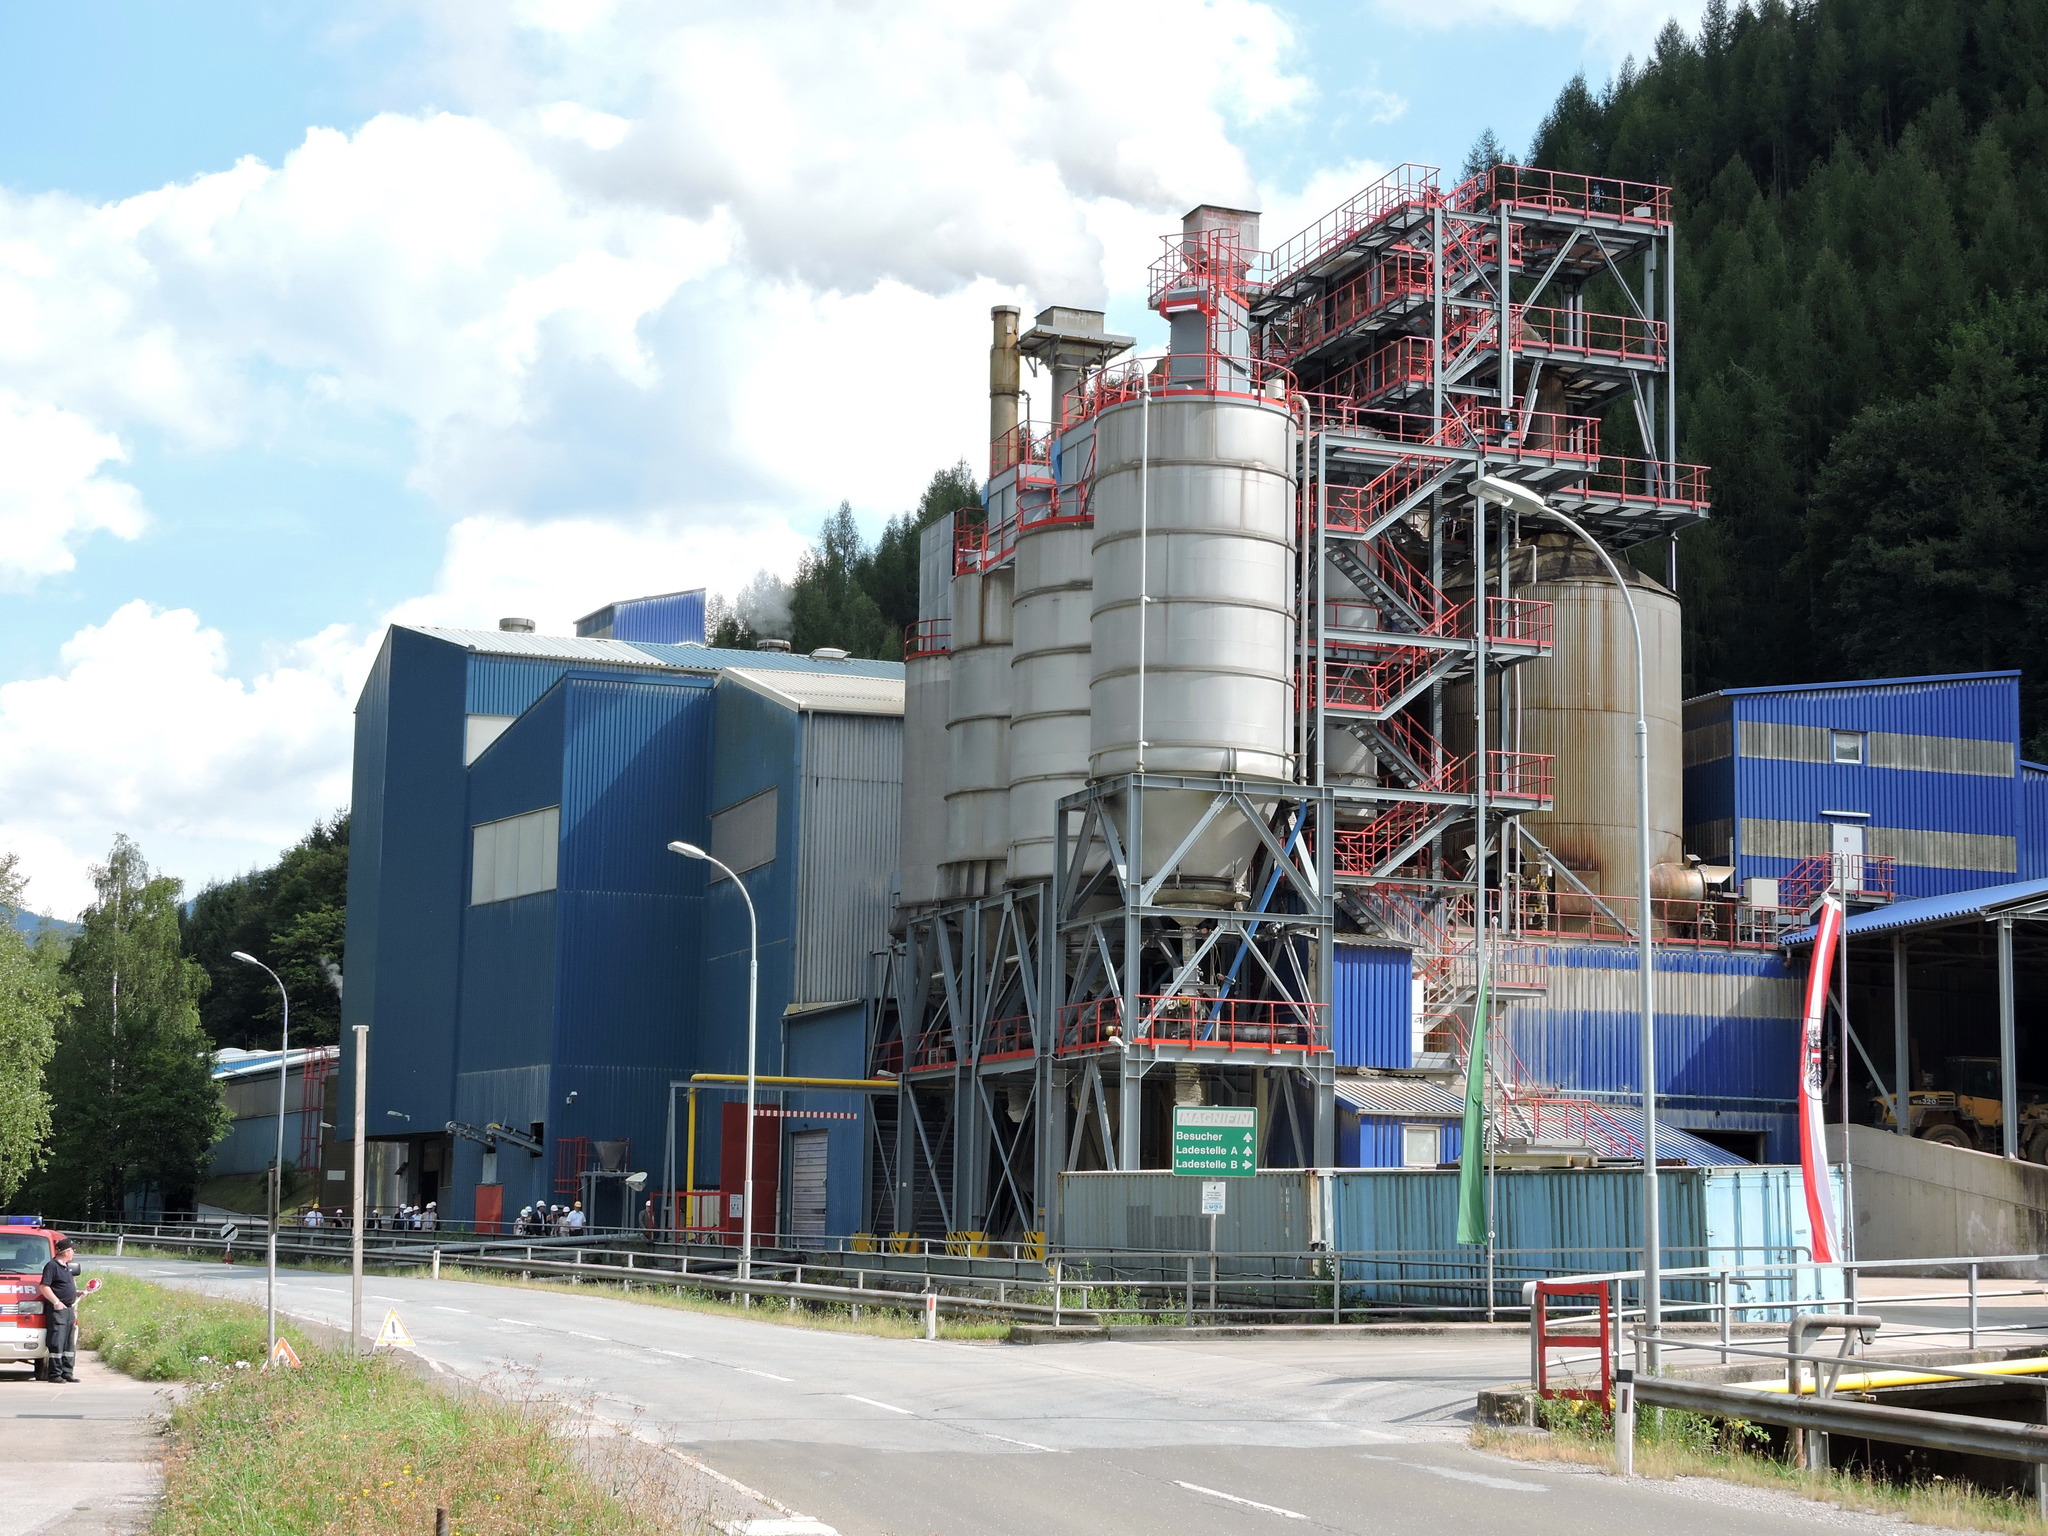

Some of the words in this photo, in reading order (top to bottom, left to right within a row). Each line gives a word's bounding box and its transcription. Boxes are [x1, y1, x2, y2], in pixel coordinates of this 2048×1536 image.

[1180, 1112, 1251, 1124] MAGNIFIN
[1176, 1131, 1223, 1141] Besucher
[1176, 1145, 1227, 1155] Ladestelle
[1230, 1146, 1238, 1155] A
[1176, 1159, 1227, 1169] Ladestelle
[1230, 1160, 1238, 1169] B
